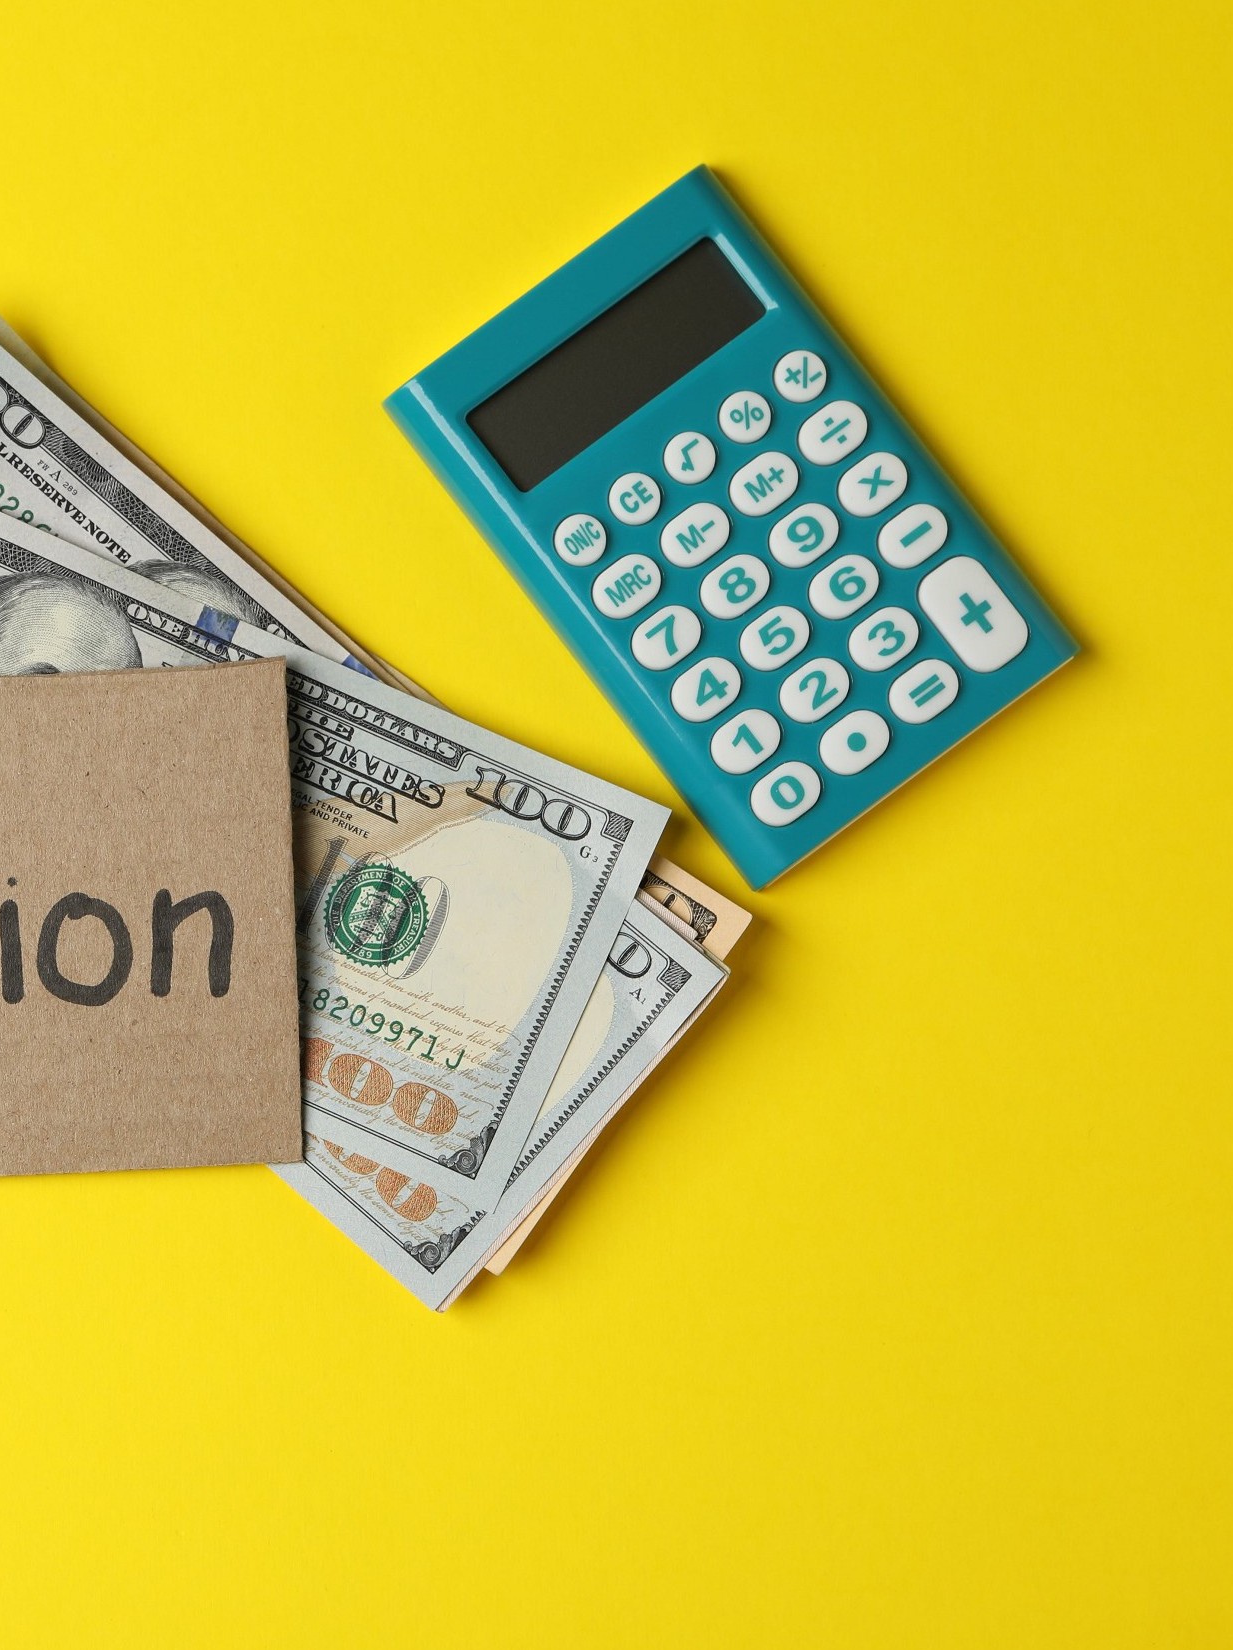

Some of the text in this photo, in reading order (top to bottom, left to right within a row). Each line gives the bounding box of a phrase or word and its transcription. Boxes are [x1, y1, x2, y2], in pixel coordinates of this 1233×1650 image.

[6, 449, 88, 526] RESERVE
[81, 516, 132, 565] NOTE
[49, 467, 62, 483] A
[564, 522, 600, 555] ON/C
[620, 481, 653, 513] CE
[730, 401, 764, 430] %
[605, 565, 651, 607] MRC
[744, 466, 785, 502] M+
[645, 614, 678, 656] 7
[719, 567, 756, 604] 8
[787, 516, 824, 552] 9
[695, 669, 729, 706] 4
[758, 616, 795, 655] 5
[829, 566, 866, 602] 6
[126, 602, 184, 639] ONE
[287, 674, 325, 701] ED
[325, 692, 459, 761] DOLLARS
[731, 724, 764, 754] 1
[799, 671, 838, 710] 2
[868, 621, 905, 657] 3
[291, 788, 353, 821] EGAL TENDER
[292, 752, 399, 824] ERICA
[298, 728, 446, 809] STATES
[465, 765, 592, 841] 100
[770, 776, 805, 809] 0
[309, 806, 331, 821] AND
[331, 817, 371, 839] PRIVATE
[393, 877, 407, 888] OF
[394, 912, 421, 955] TREASURY
[301, 1037, 459, 1135] 100
[445, 1049, 466, 1070] J
